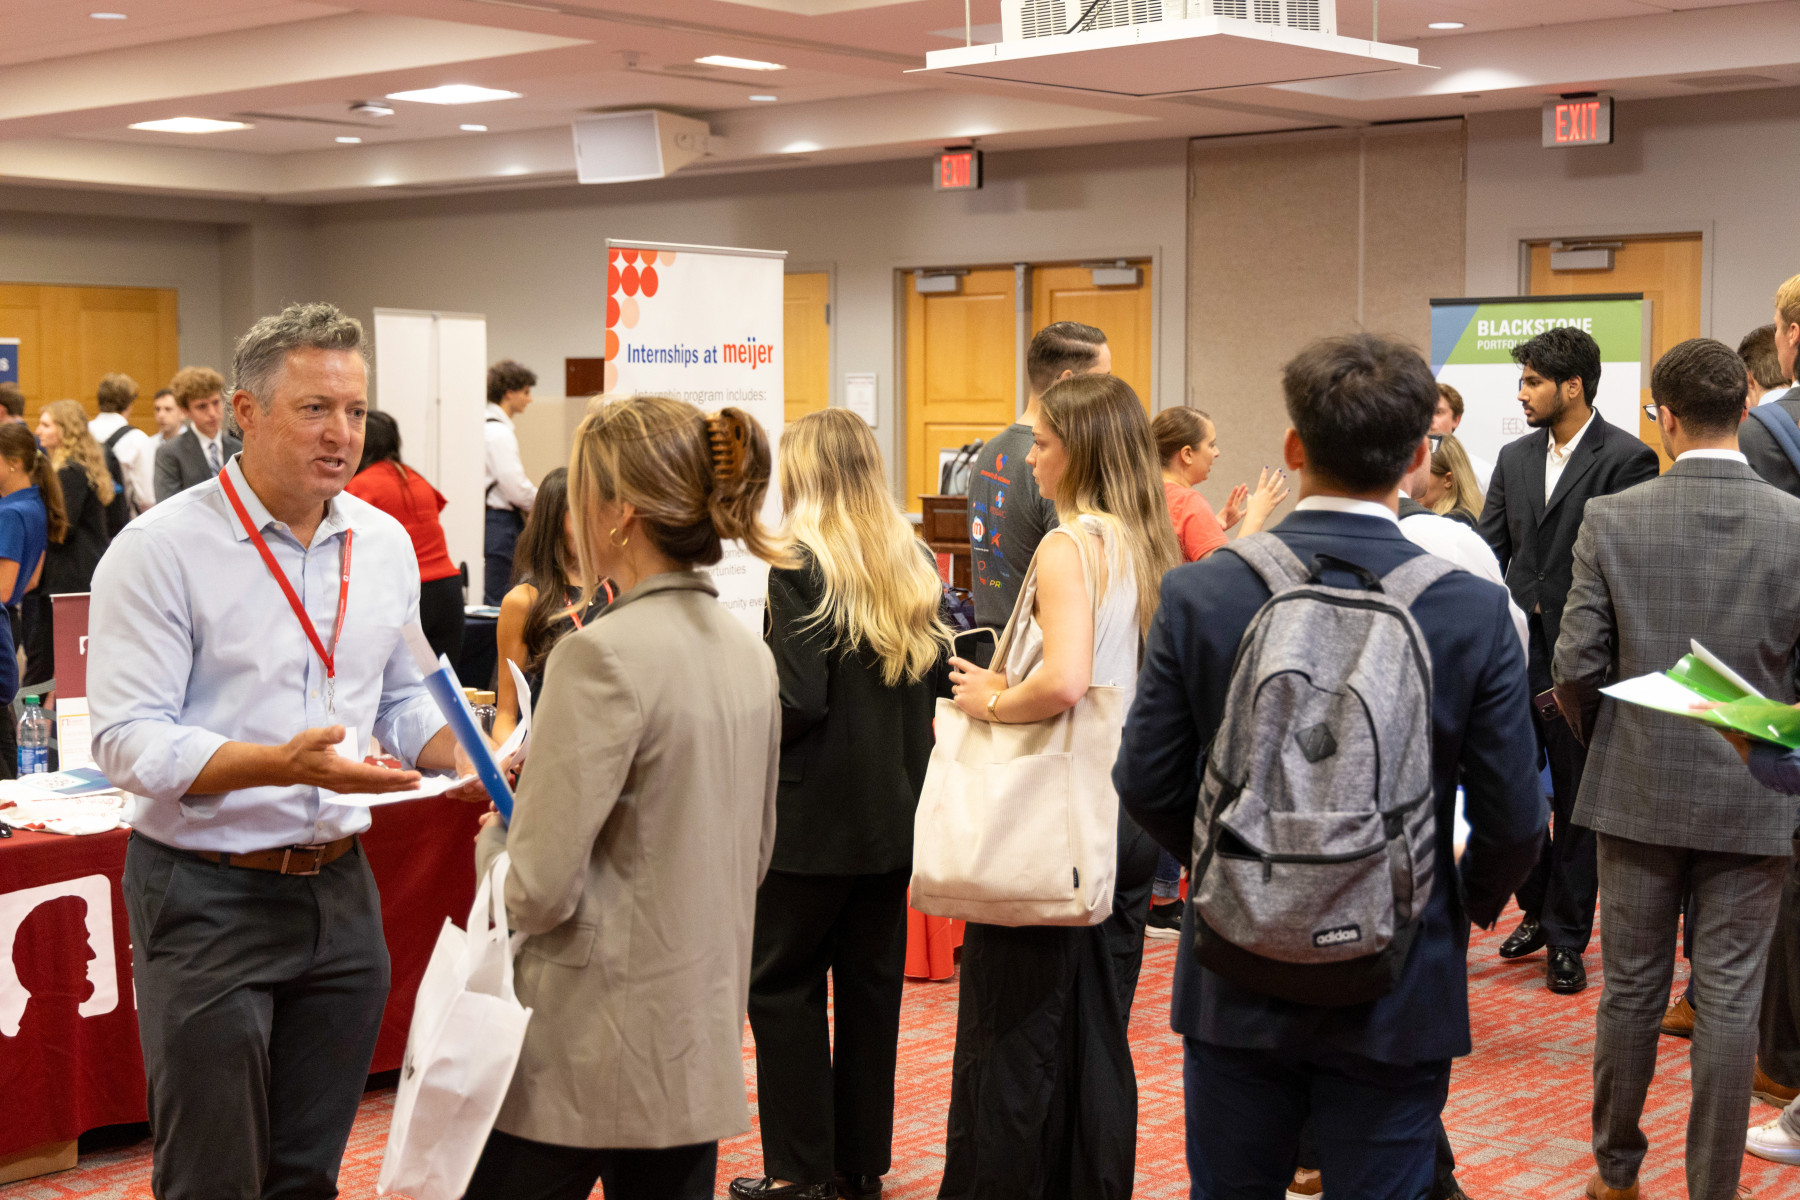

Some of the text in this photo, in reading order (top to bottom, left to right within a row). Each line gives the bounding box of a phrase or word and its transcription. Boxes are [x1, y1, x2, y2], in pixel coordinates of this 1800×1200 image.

[1555, 102, 1600, 142] EXIT
[941, 153, 972, 187] EXIT
[1477, 318, 1593, 336] BLACKSTONE
[627, 337, 774, 370] Internships at meijer
[683, 390, 724, 404] program
[726, 388, 767, 401] includes:
[709, 564, 747, 577] ortunities
[721, 598, 747, 610] munity
[1316, 929, 1358, 945] adidas
